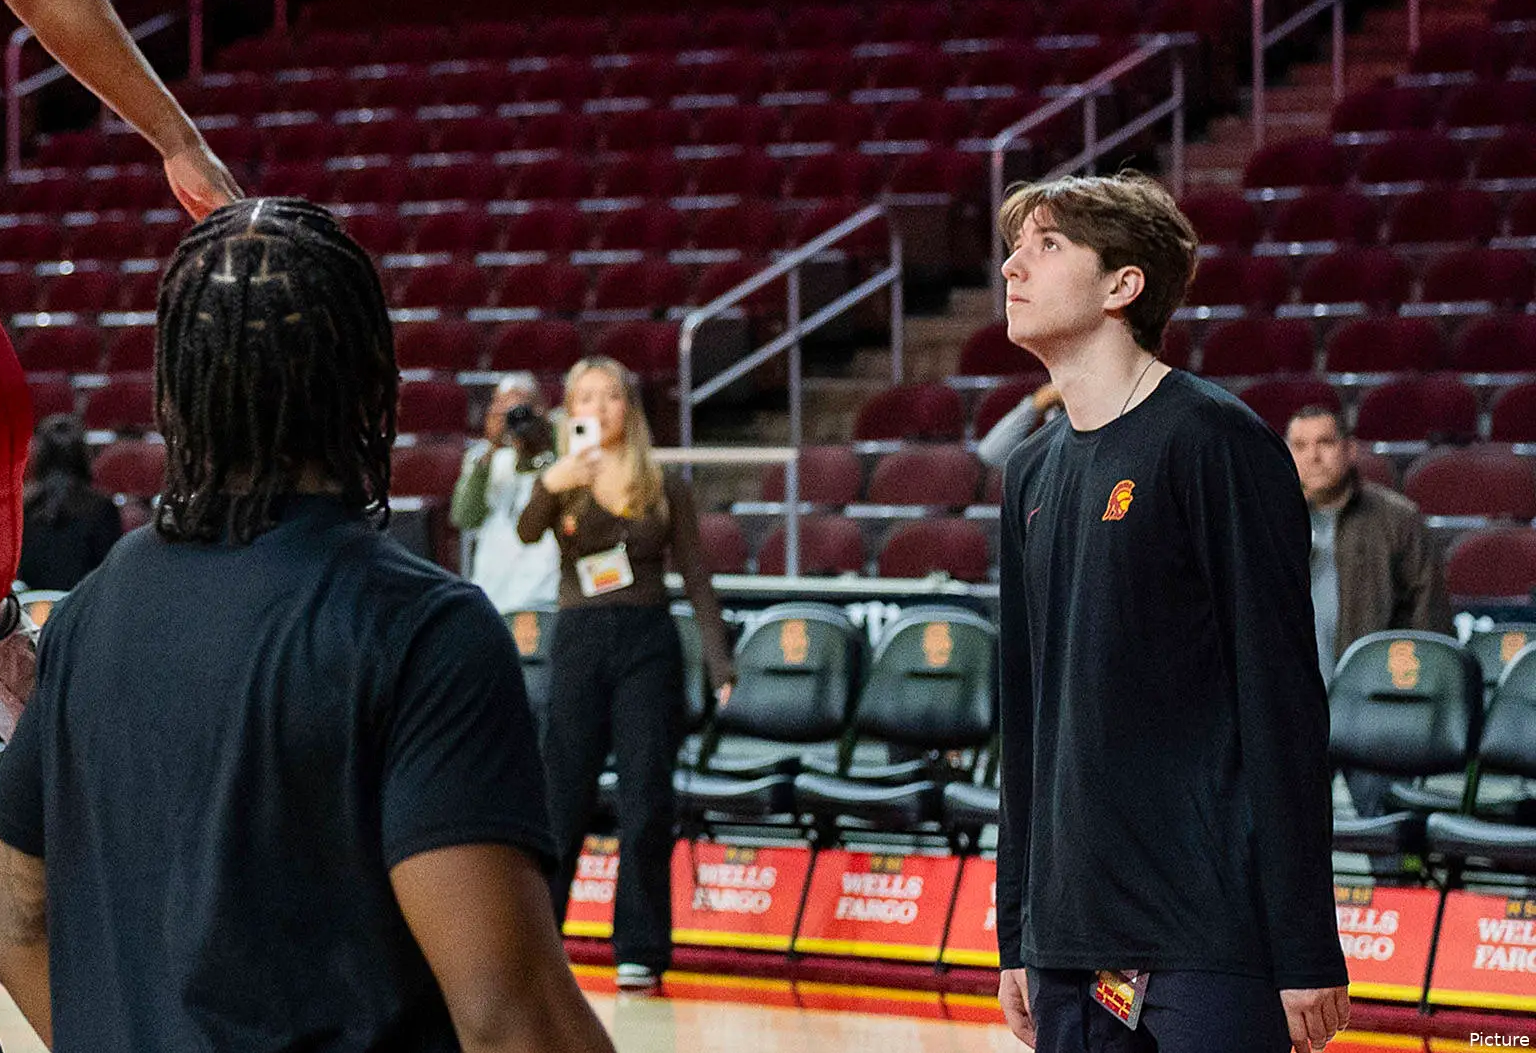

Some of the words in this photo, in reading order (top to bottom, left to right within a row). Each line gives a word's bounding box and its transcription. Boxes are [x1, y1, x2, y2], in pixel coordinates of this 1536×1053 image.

[697, 863, 777, 890] WELLS
[842, 872, 924, 899] WELLS
[835, 896, 918, 924] FARGO
[1336, 907, 1399, 935] ELLS
[1478, 918, 1536, 945] WEL
[1339, 933, 1395, 961] RGO
[1472, 944, 1536, 973] FAR
